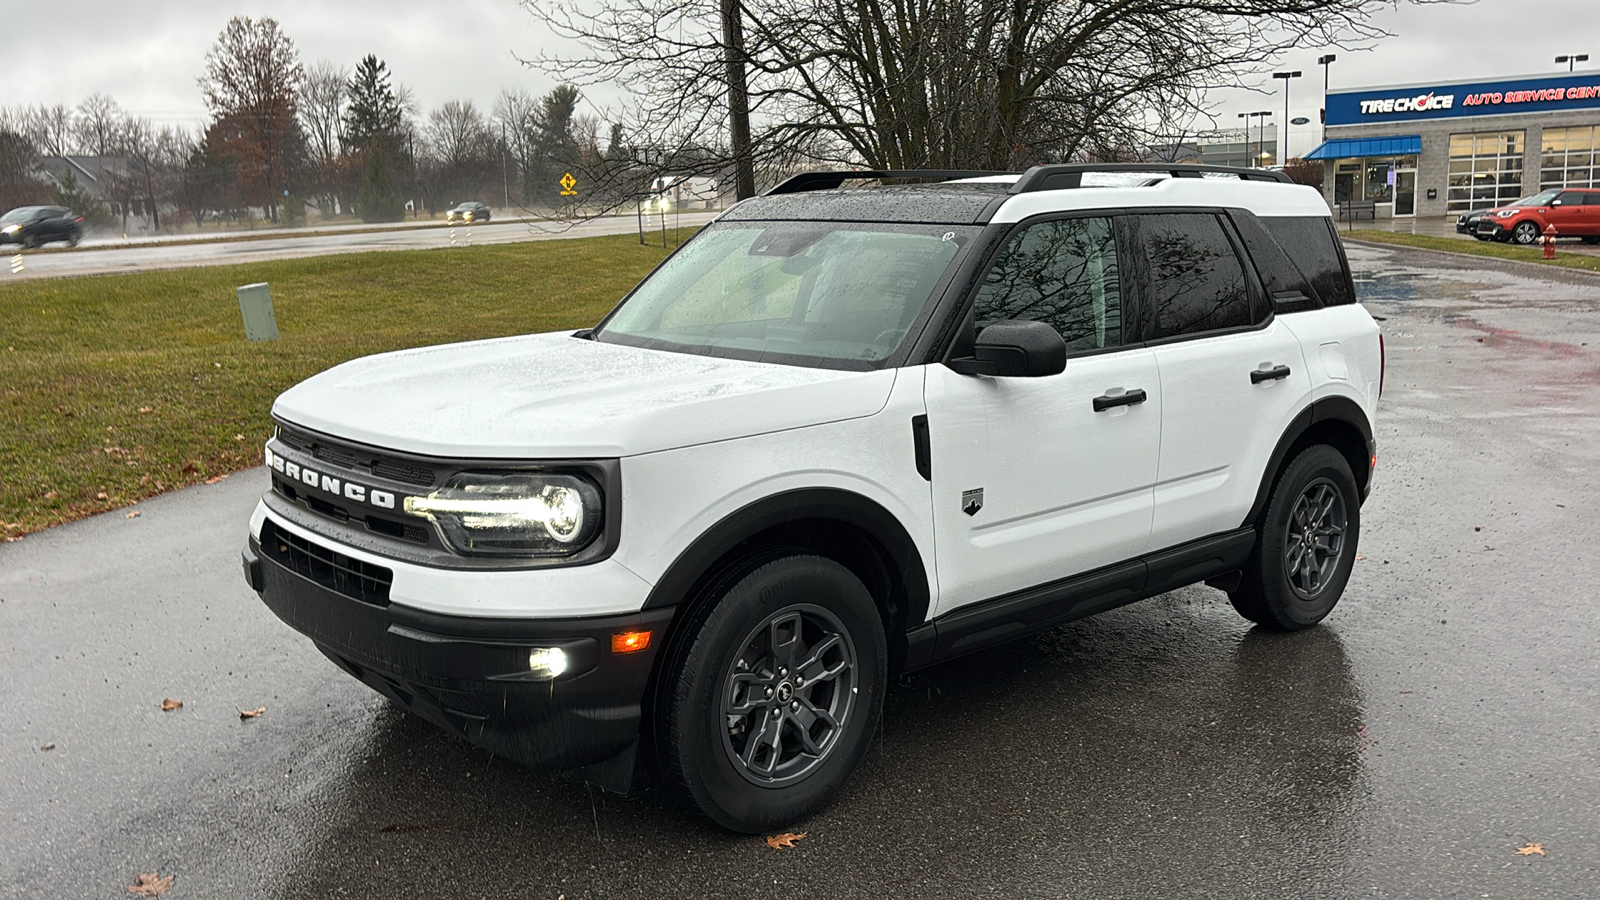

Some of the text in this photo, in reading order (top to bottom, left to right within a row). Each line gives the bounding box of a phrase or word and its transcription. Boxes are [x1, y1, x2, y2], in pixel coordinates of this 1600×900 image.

[1463, 93, 1502, 106] AUTO
[1504, 88, 1565, 103] SERVICE
[273, 454, 395, 509] BRONCO
